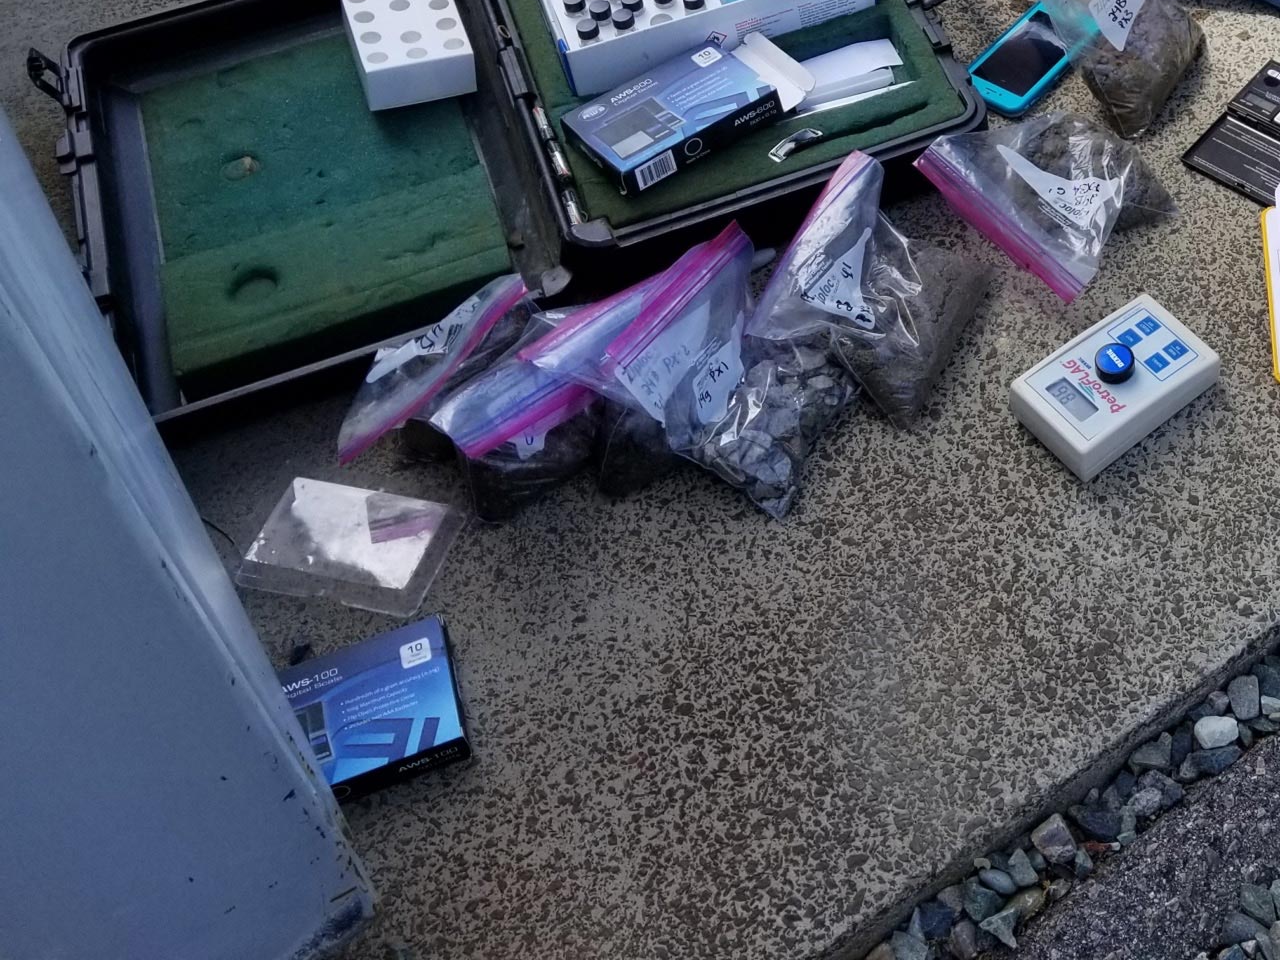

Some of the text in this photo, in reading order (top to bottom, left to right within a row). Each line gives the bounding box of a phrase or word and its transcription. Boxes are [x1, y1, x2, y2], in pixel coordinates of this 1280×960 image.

[734, 100, 775, 127] AWS-600
[1105, 348, 1125, 368] DEXSIL
[1062, 359, 1126, 414] PetroFLAG
[407, 642, 423, 654] 10
